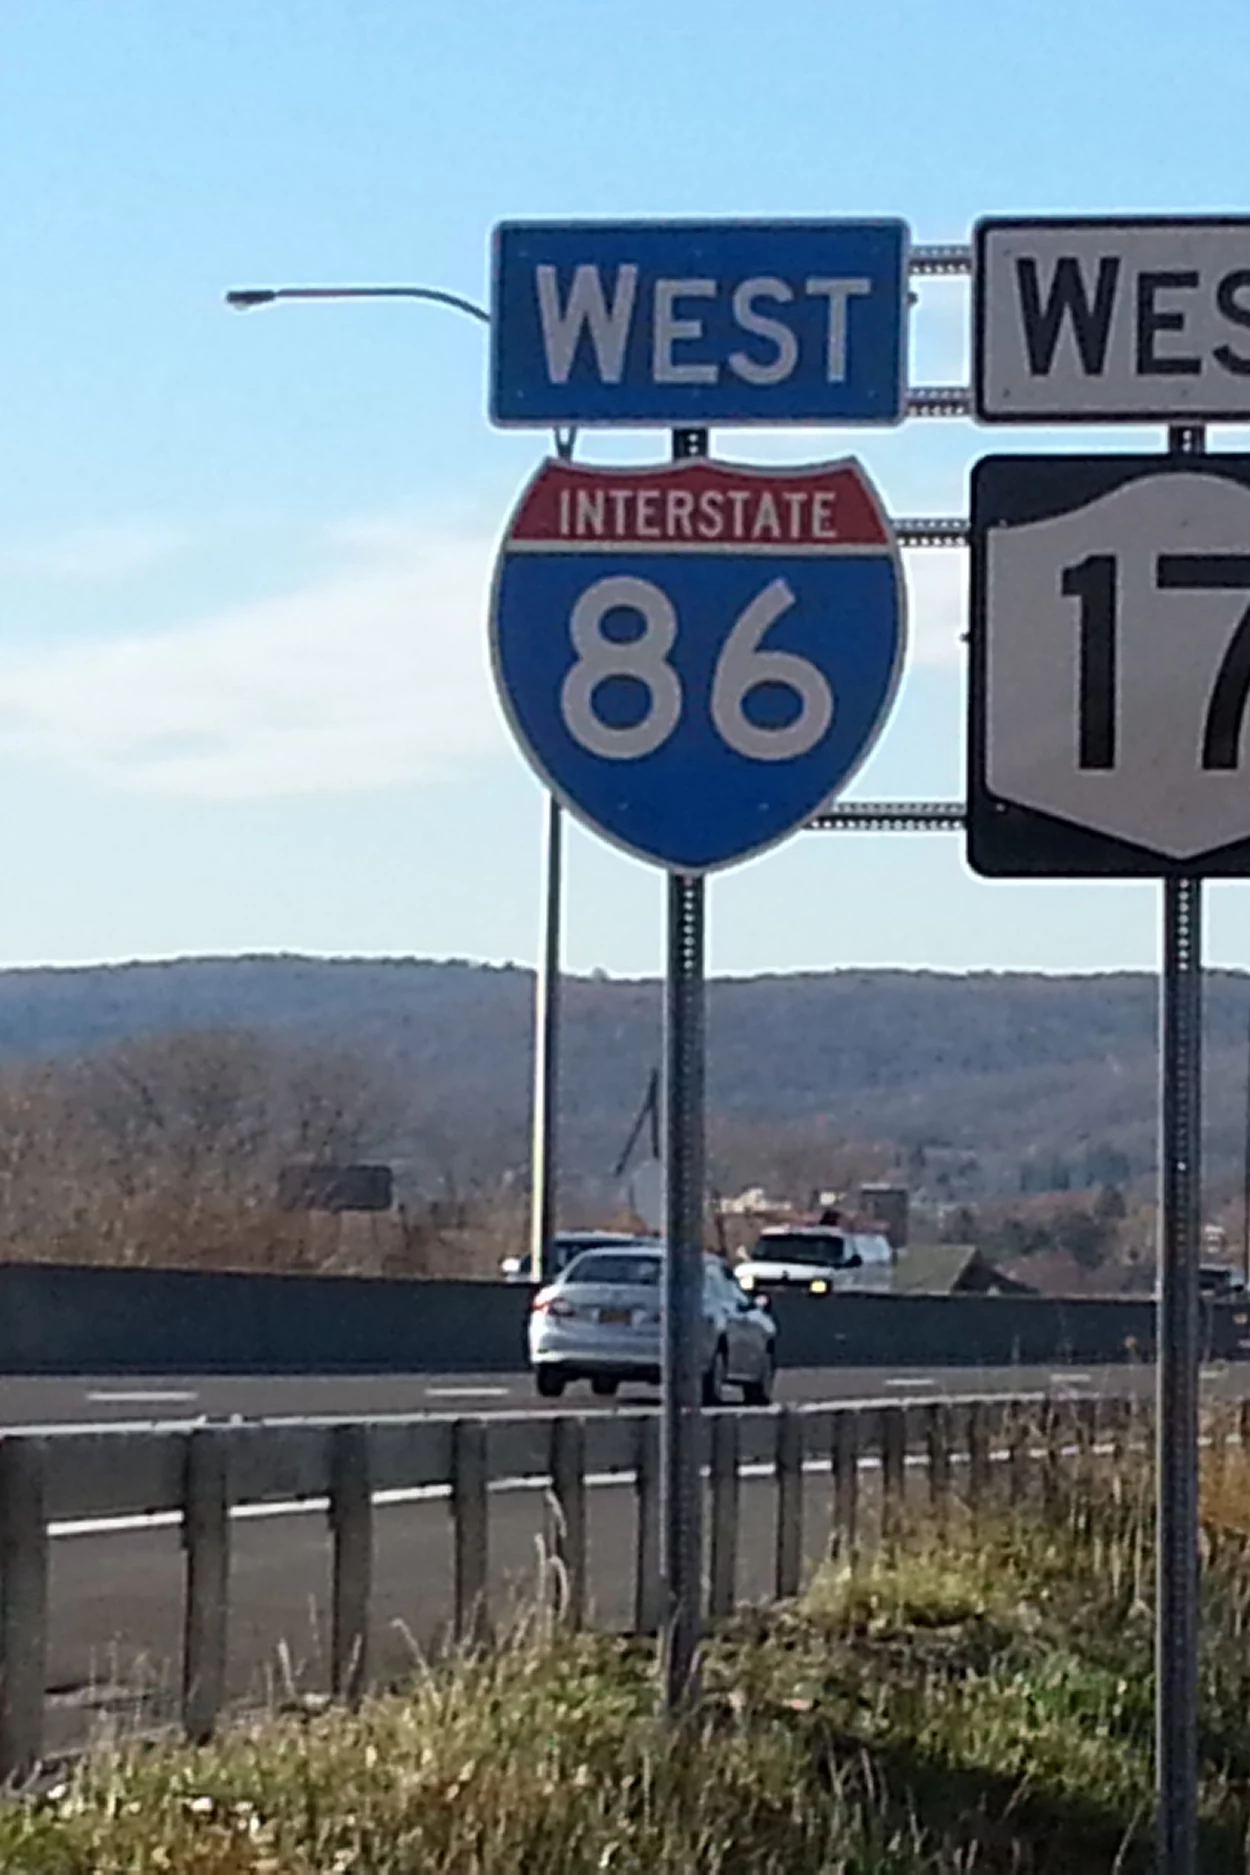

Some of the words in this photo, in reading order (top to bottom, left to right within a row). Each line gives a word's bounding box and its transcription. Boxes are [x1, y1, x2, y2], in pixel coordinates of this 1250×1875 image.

[536, 264, 871, 385] WEST
[559, 488, 837, 539] INTERSTATE
[561, 577, 835, 762] 86
